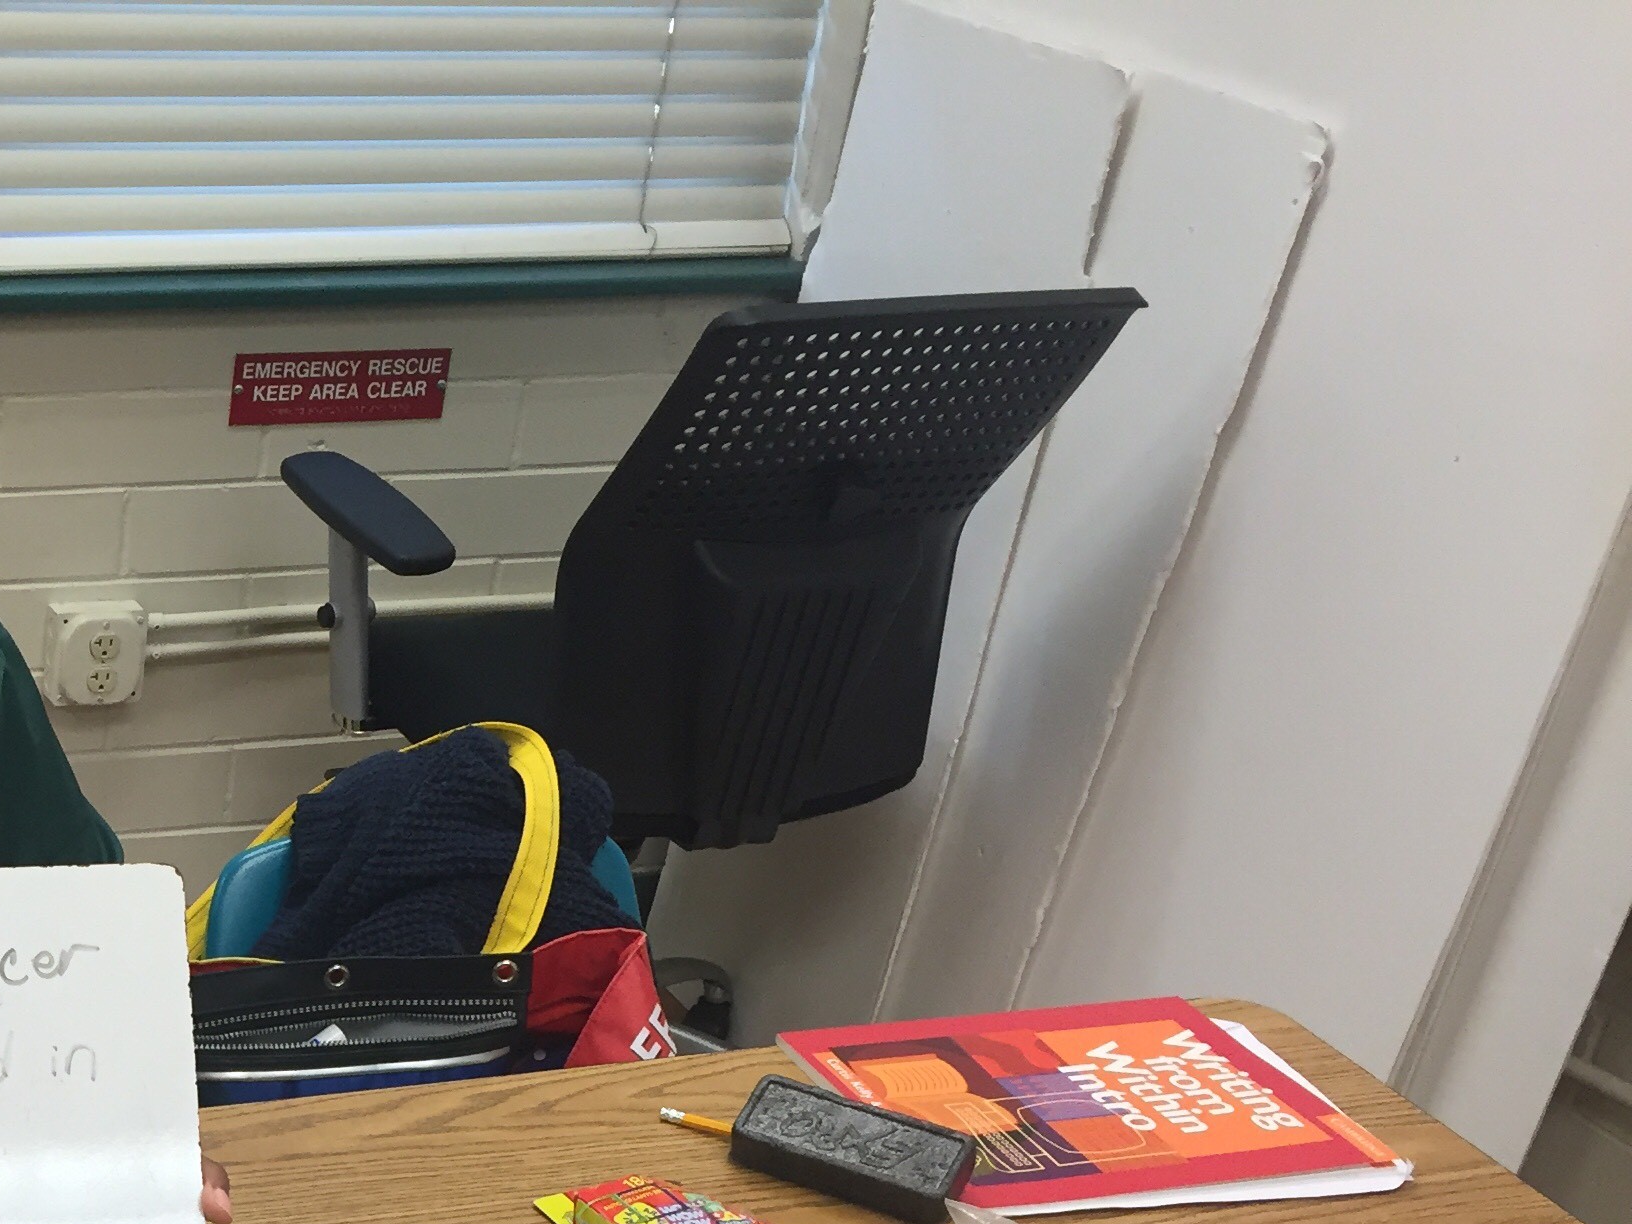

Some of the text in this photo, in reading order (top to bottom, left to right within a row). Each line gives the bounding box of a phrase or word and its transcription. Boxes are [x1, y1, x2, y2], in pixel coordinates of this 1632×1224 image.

[242, 357, 444, 379] EMERGENCY RESCUE
[252, 380, 428, 402] KEEP AREA CLEAR
[50, 1043, 99, 1083] in
[1085, 1040, 1209, 1134] Within
[1143, 1055, 1235, 1116] from
[1162, 1028, 1305, 1131] Writing
[1057, 1063, 1158, 1131] Intro
